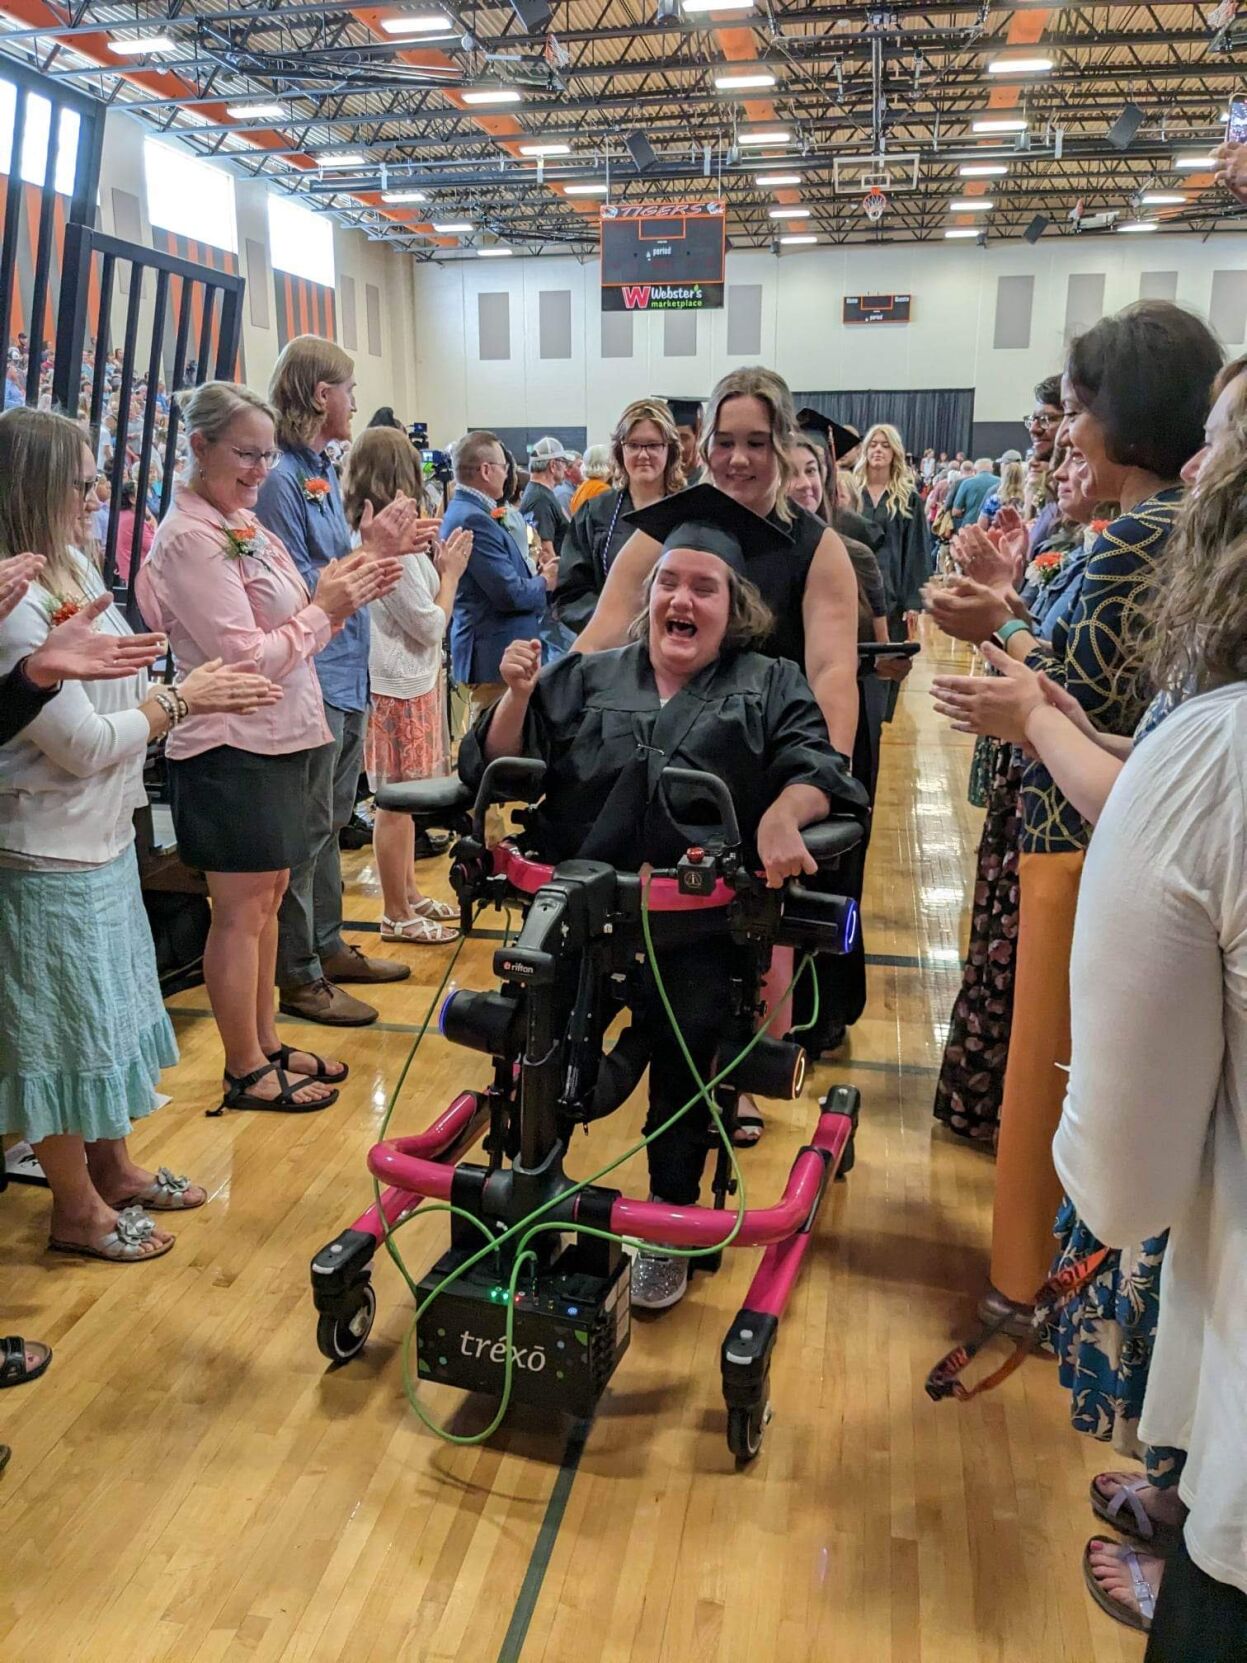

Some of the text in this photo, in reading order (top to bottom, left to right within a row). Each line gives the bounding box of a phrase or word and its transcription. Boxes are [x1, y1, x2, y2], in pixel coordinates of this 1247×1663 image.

[621, 203, 706, 217] TIGERS
[652, 246, 672, 257] period
[621, 286, 651, 309] W
[651, 284, 703, 299] Webster's
[651, 300, 703, 309] marketplace
[511, 962, 534, 974] rifton
